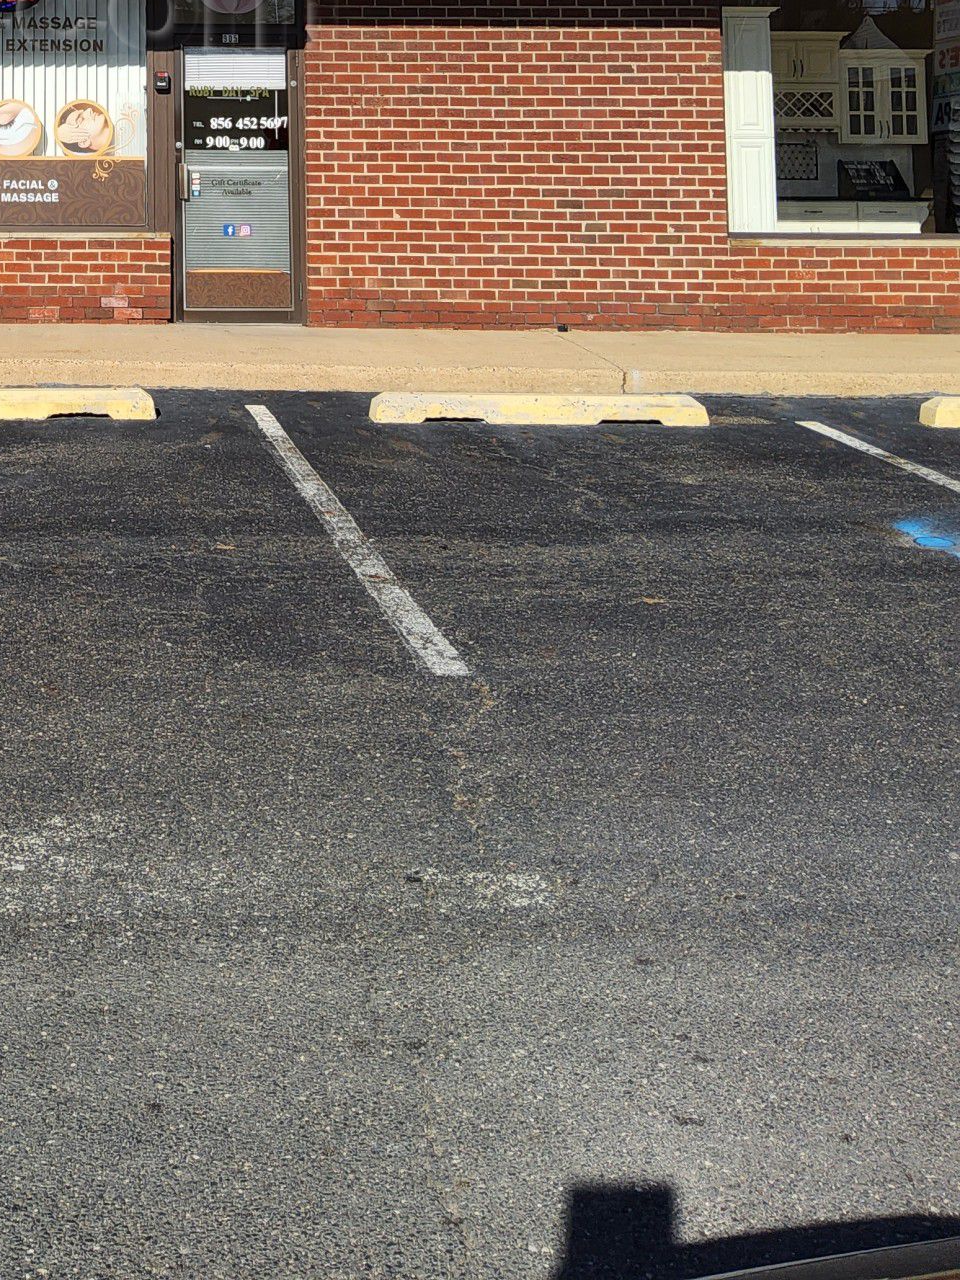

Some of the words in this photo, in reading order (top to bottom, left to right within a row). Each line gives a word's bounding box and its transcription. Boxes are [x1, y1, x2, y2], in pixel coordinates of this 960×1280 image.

[12, 16, 98, 29] MASSAGE
[5, 39, 104, 52] EXTENSION
[189, 85, 214, 97] RUBY
[221, 86, 242, 97] DAY
[249, 86, 270, 98] SPA
[210, 117, 232, 130] 856
[235, 117, 258, 130] 452
[259, 116, 288, 130] 5697
[3, 179, 44, 190] FACIAL
[47, 179, 58, 190] &
[211, 179, 226, 187] Gift
[0, 192, 60, 203] MASSAGE
